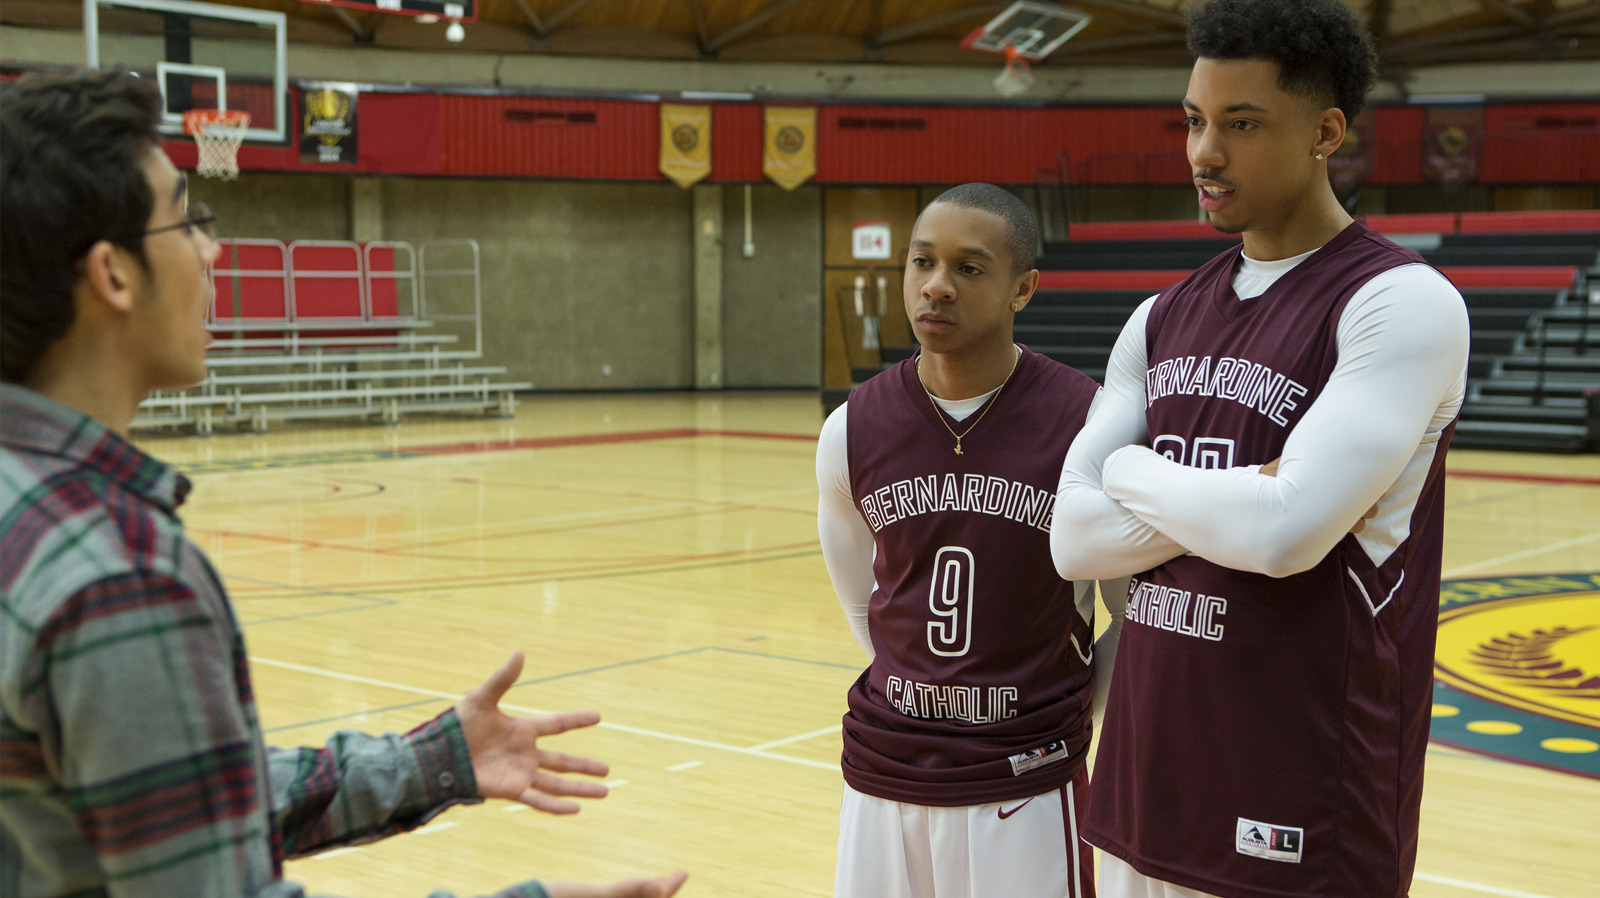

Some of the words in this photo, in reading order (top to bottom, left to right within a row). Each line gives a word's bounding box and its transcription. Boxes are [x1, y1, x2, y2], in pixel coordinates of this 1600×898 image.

[1144, 356, 1309, 428] ERNARDINE
[927, 546, 975, 657] 9
[1125, 577, 1228, 642] CATHOLIC
[886, 675, 1018, 724] CATHOLIC
[1284, 834, 1293, 848] L
